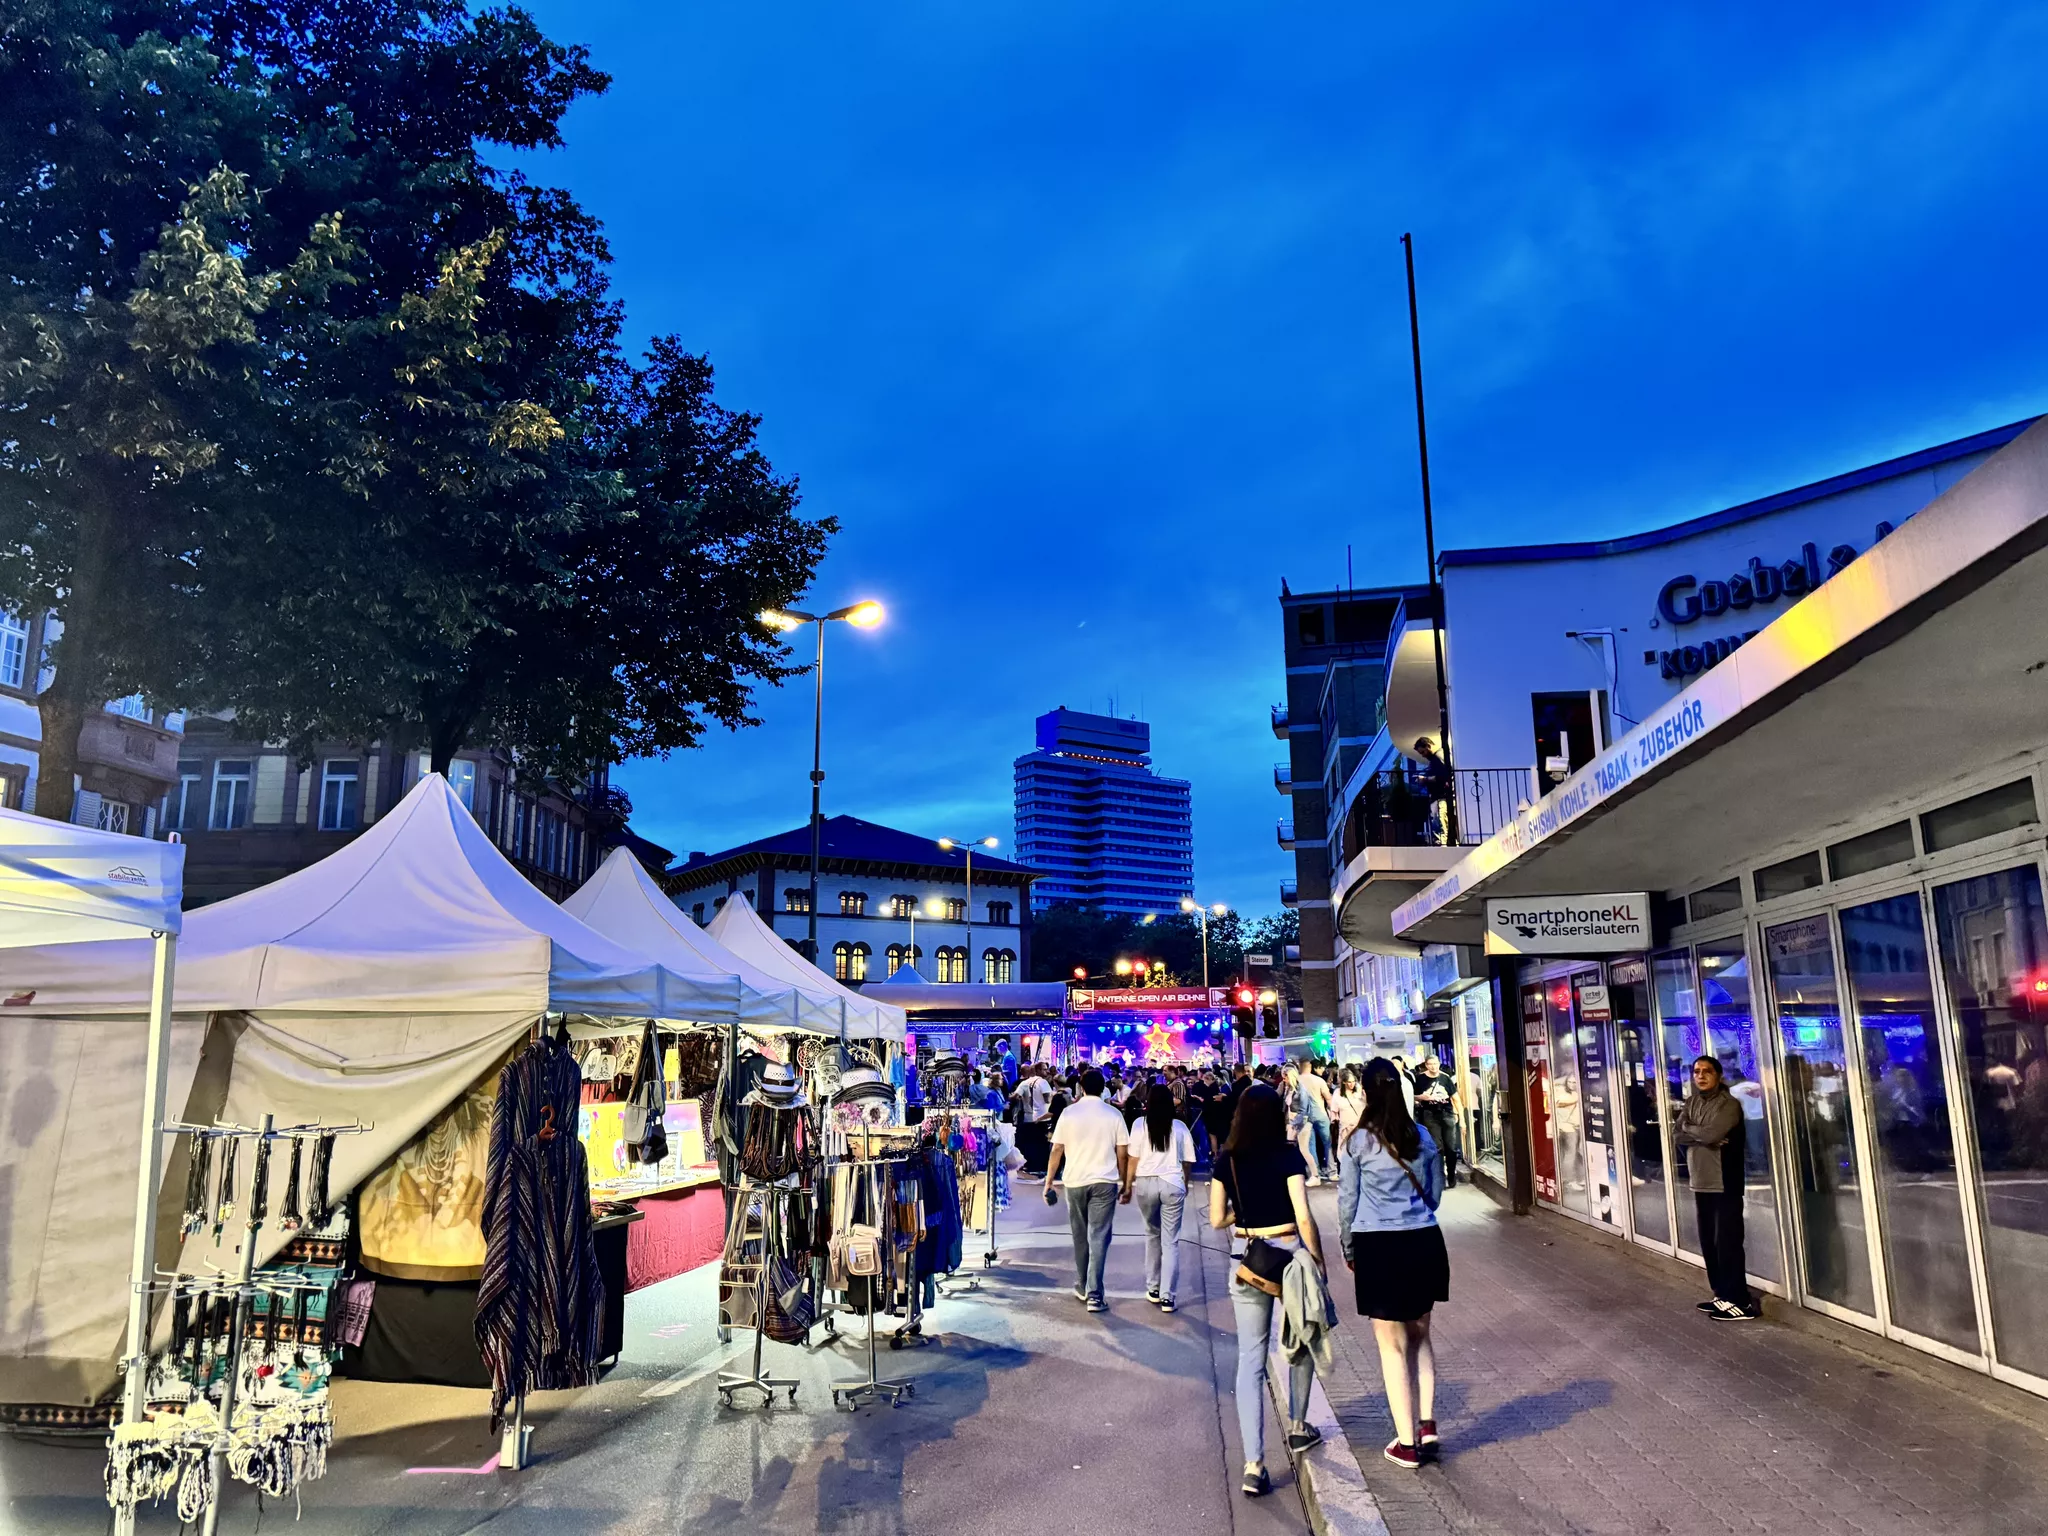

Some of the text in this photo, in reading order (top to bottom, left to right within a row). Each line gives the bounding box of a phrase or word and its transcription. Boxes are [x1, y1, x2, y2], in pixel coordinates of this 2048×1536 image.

[1658, 542, 1820, 624] Goebel
[1528, 808, 1558, 842] SHISHA
[1559, 781, 1590, 821] KOHLE
[1594, 751, 1632, 797] TABAK
[1638, 699, 1705, 768] ZUBEHÖR
[1497, 905, 1639, 926] SmartphoneKL
[1541, 923, 1640, 937] Kaiserslautern
[1097, 993, 1206, 1003] ANTENNE OPEN AIR BÜHNE
